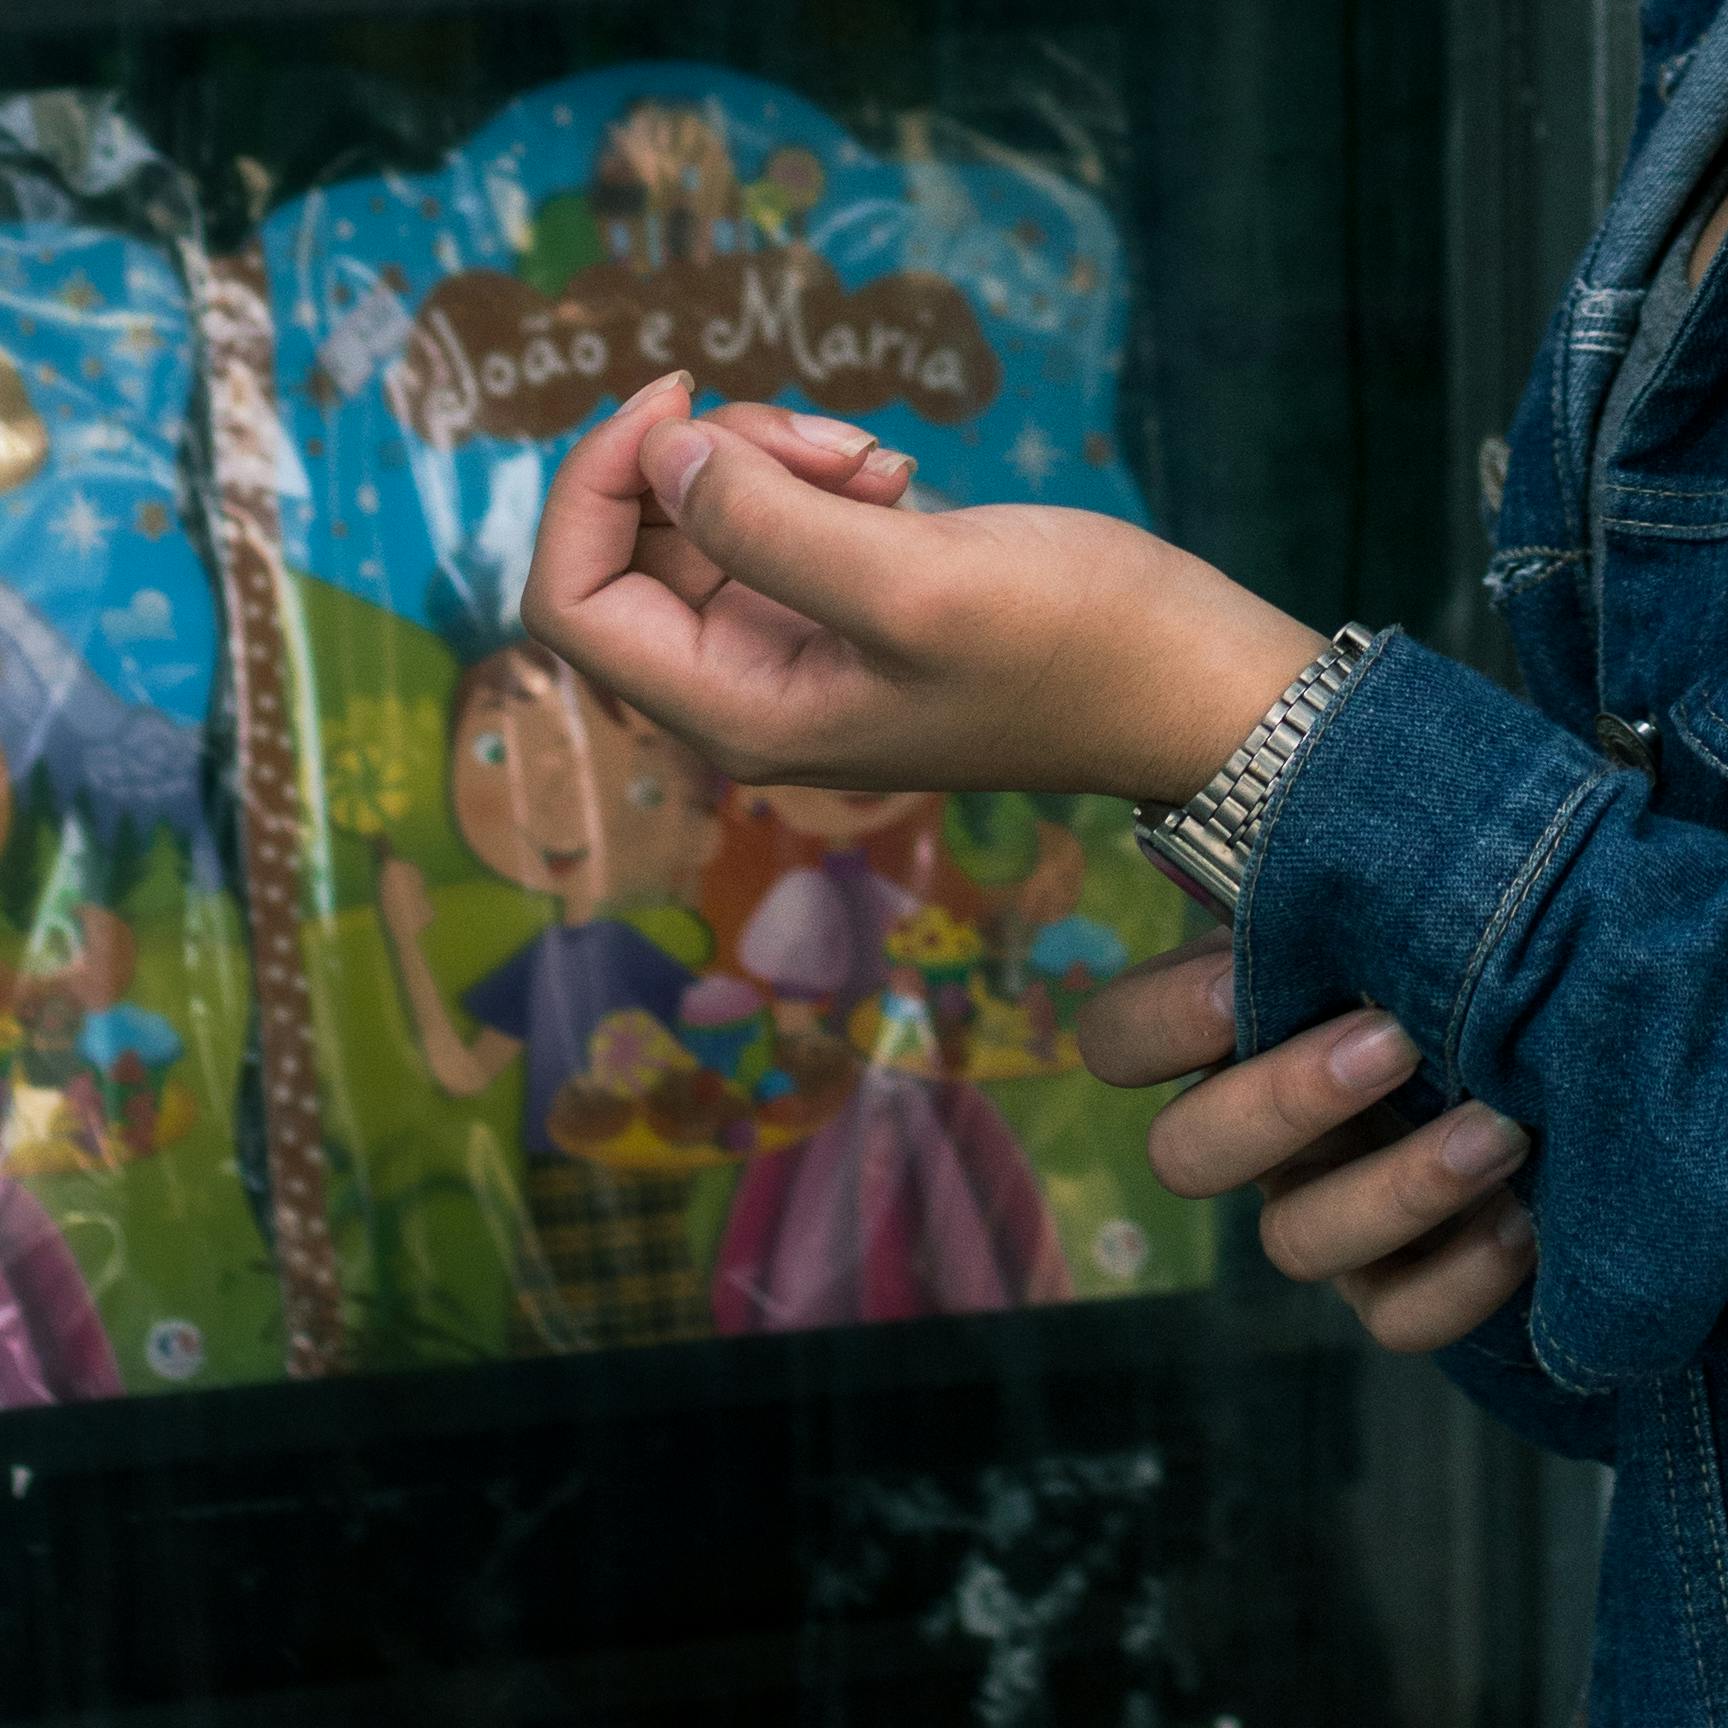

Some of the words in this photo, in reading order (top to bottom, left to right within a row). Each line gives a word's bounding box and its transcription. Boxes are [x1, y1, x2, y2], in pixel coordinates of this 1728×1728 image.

[420, 304, 608, 440] João
[641, 311, 674, 365] e
[702, 268, 968, 396] Maria
